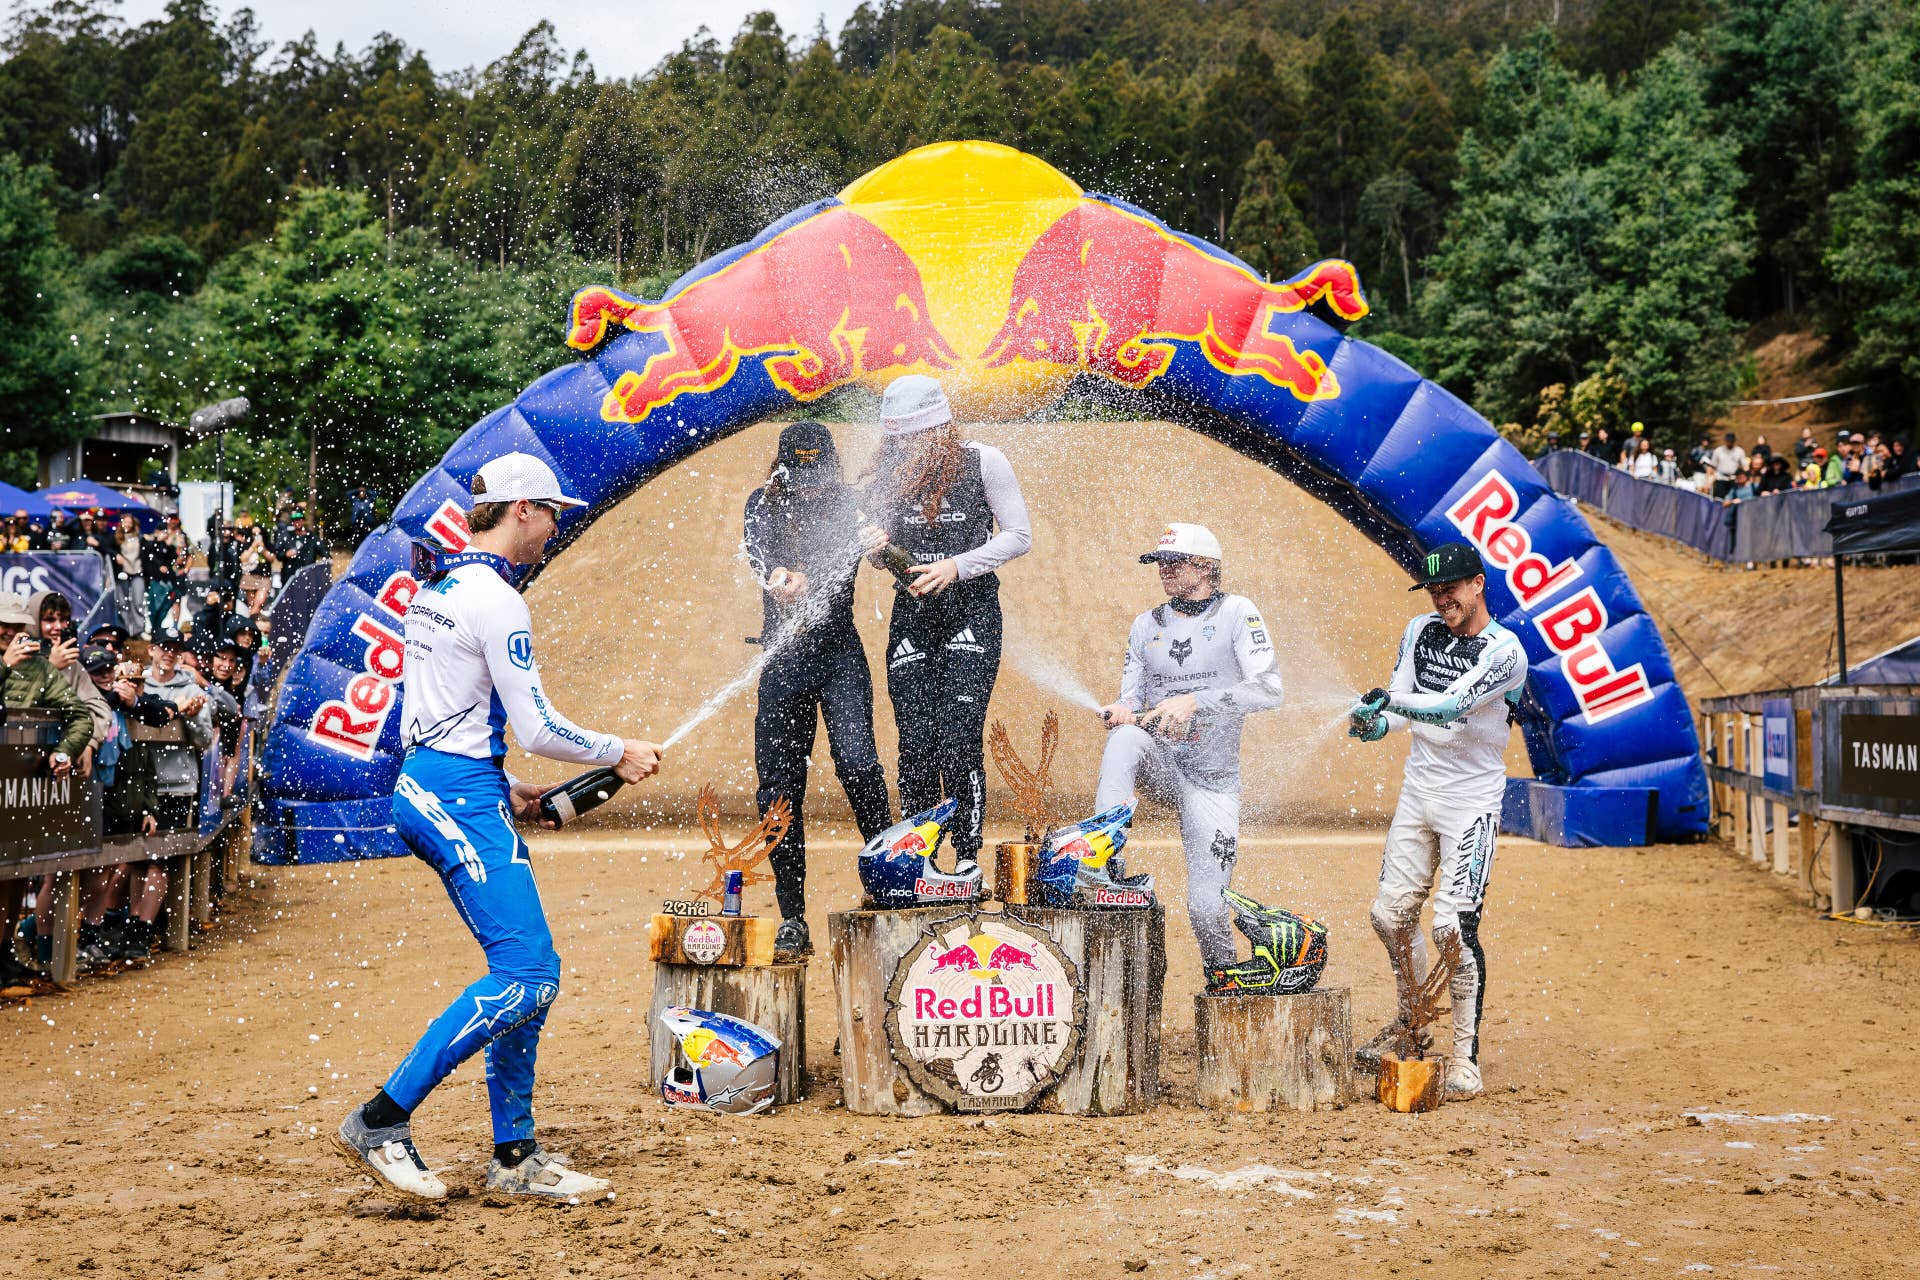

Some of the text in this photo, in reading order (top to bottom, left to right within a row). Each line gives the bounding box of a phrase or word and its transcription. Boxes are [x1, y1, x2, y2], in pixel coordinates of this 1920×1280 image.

[903, 512, 966, 524] NOCO
[444, 554, 497, 565] OAKLEY
[0, 565, 50, 611] GS
[1450, 473, 1651, 720] Red Bull
[310, 499, 472, 757] Red Bll
[945, 643, 985, 654] NORCO
[1419, 645, 1474, 671] CANYON
[890, 652, 926, 670] NORCO
[1426, 663, 1462, 678] SRAM
[1471, 678, 1488, 701] Lee
[1484, 649, 1518, 685] Designs
[1852, 741, 1918, 772] TASMAN
[0, 775, 71, 809] MANIAN
[915, 879, 972, 897] Red Bull
[1096, 888, 1125, 903] Red
[678, 902, 708, 916] 2nd
[705, 935, 721, 943] Bull
[915, 983, 1055, 1020] Red Bull
[485, 1008, 540, 1044] MOND
[914, 1022, 1057, 1048] HARDLINE
[960, 1096, 1019, 1107] TASMANIA
